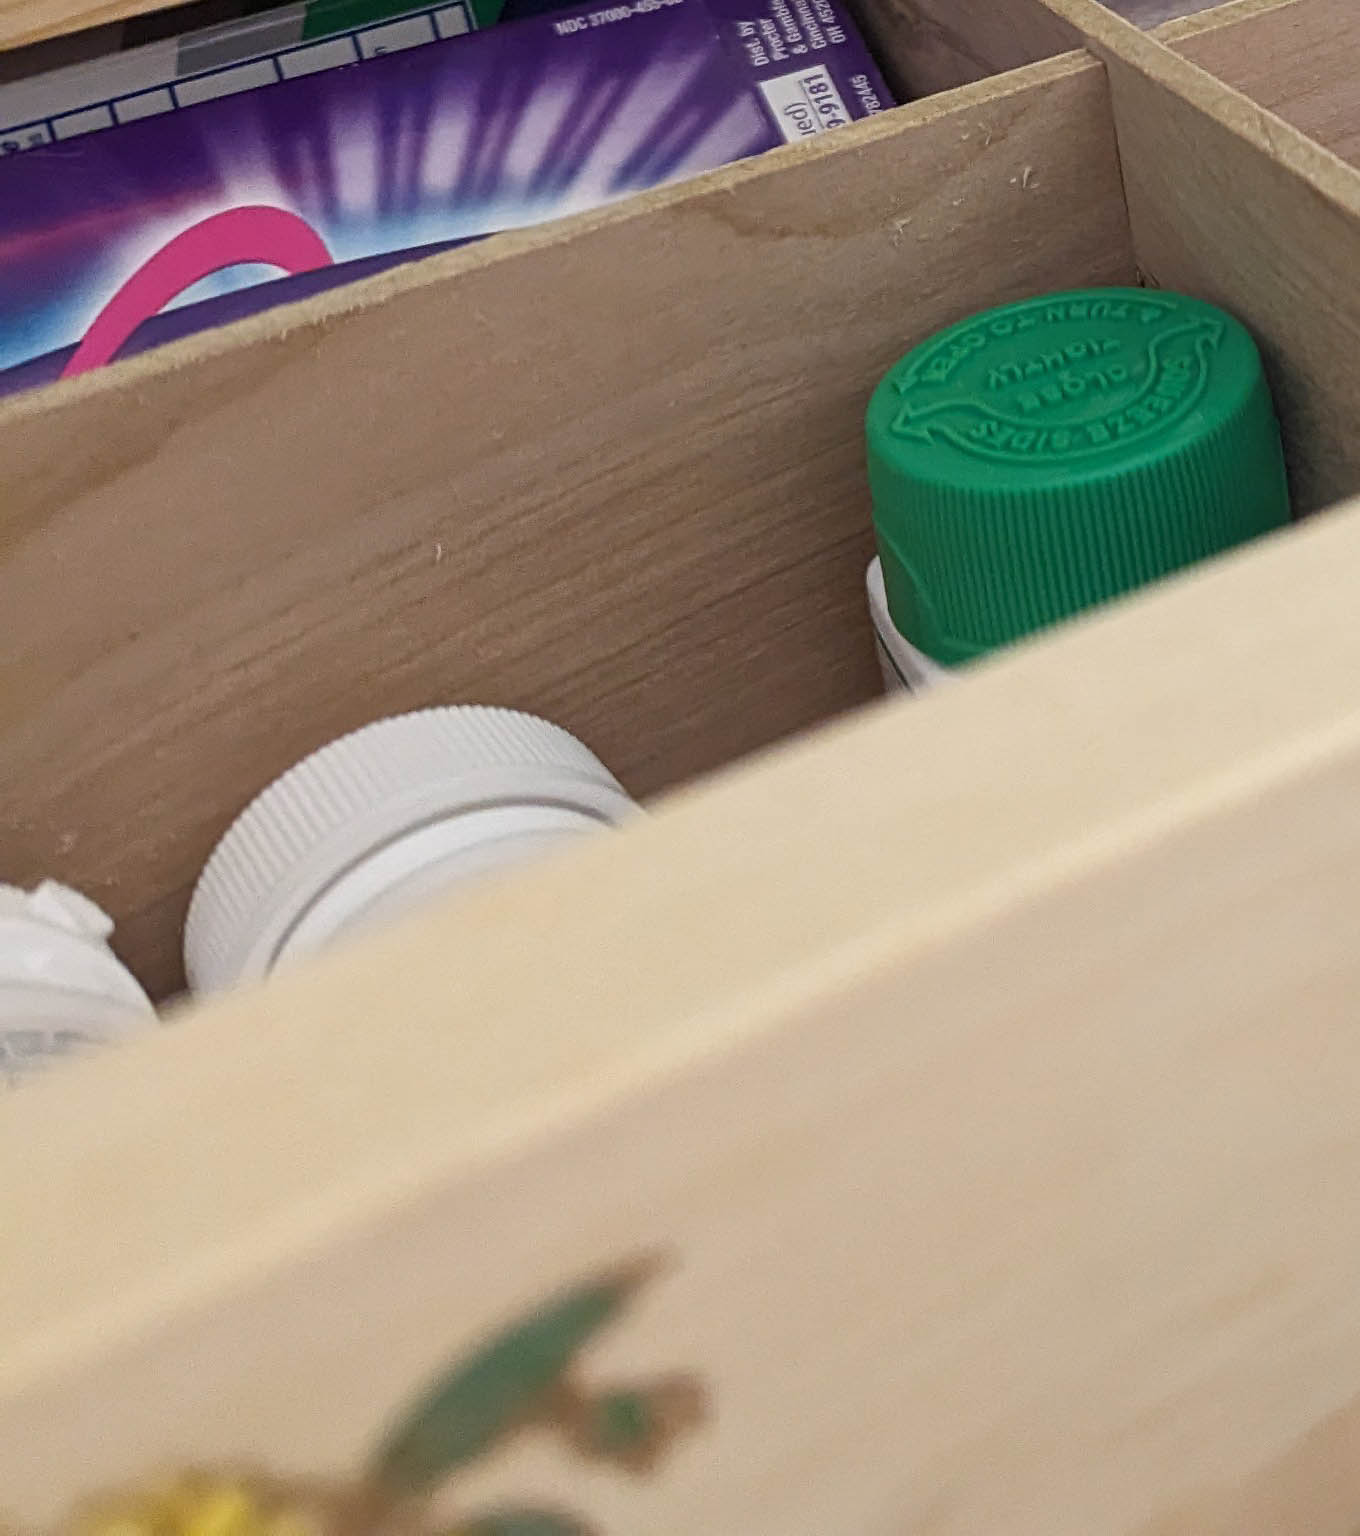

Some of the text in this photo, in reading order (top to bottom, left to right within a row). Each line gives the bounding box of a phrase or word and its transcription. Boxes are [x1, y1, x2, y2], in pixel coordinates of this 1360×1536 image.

[555, 16, 588, 36] NDC
[736, 20, 756, 38] by
[825, 25, 847, 44] OH
[759, 18, 790, 62] Procter
[791, 39, 809, 55] &
[1046, 301, 1128, 321] TURN
[990, 316, 1037, 334] TO
